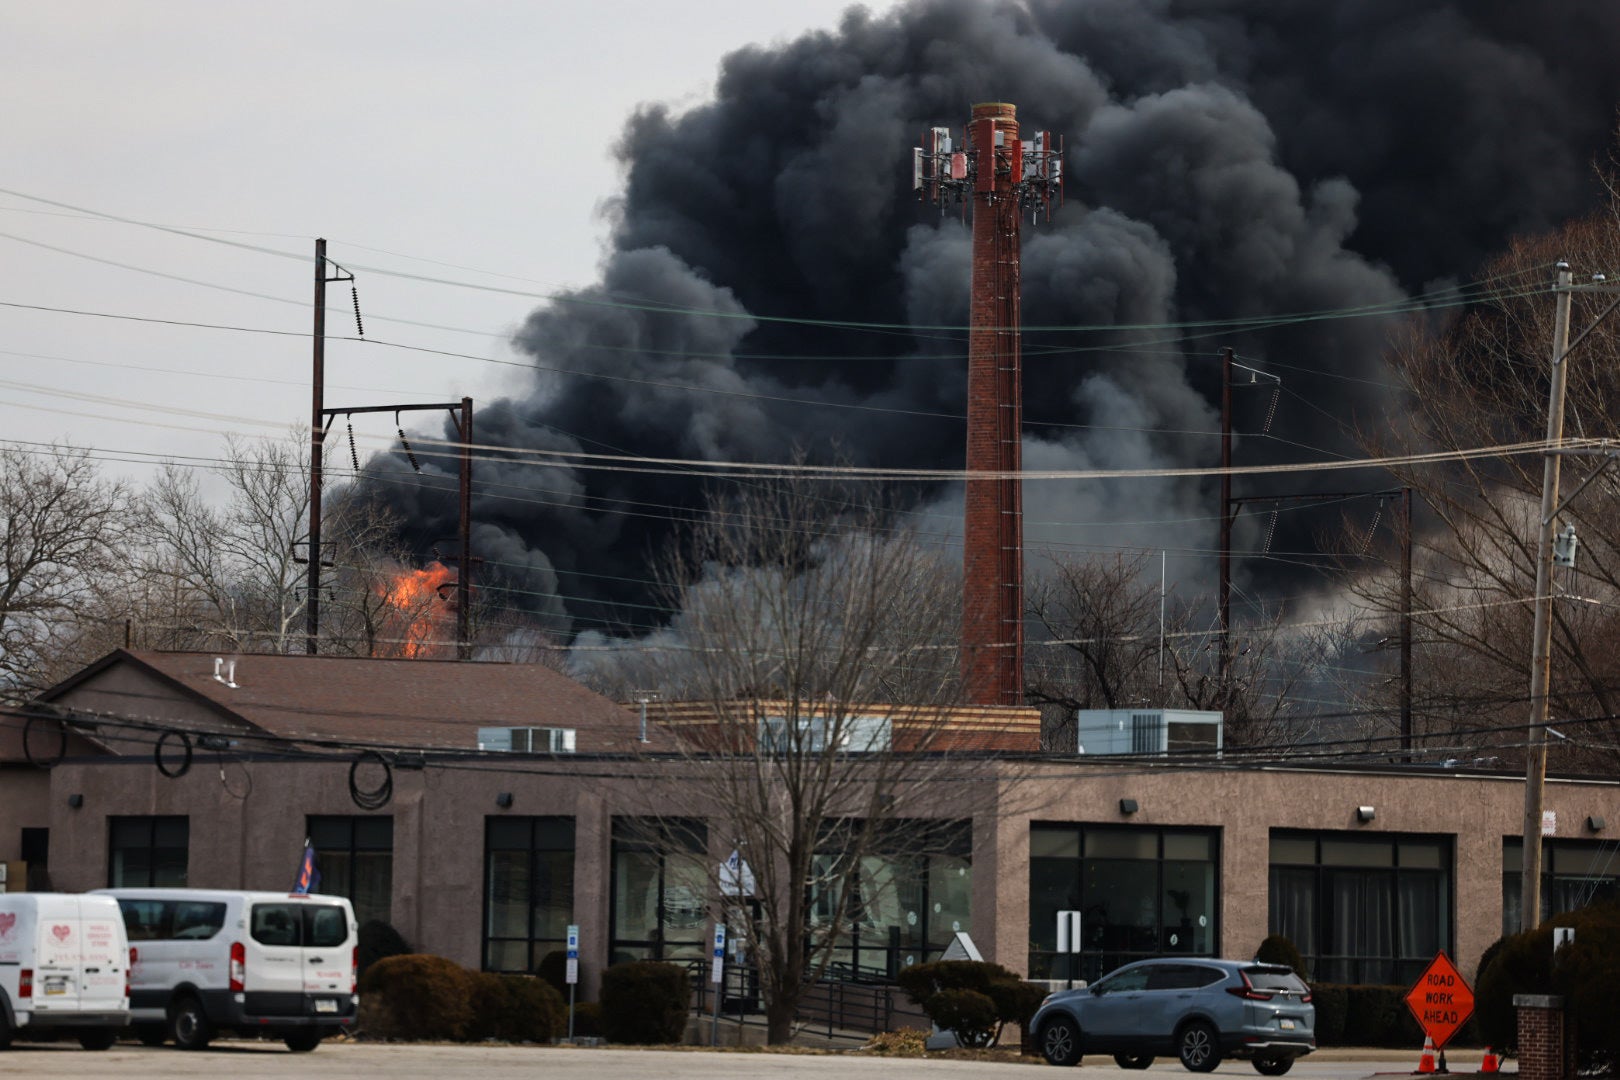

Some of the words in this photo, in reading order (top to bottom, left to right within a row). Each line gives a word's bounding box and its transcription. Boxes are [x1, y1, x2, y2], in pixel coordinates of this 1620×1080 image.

[1427, 974, 1454, 987] ROAD
[1426, 992, 1453, 1004] WORK
[1423, 1010, 1458, 1024] AHEAD
